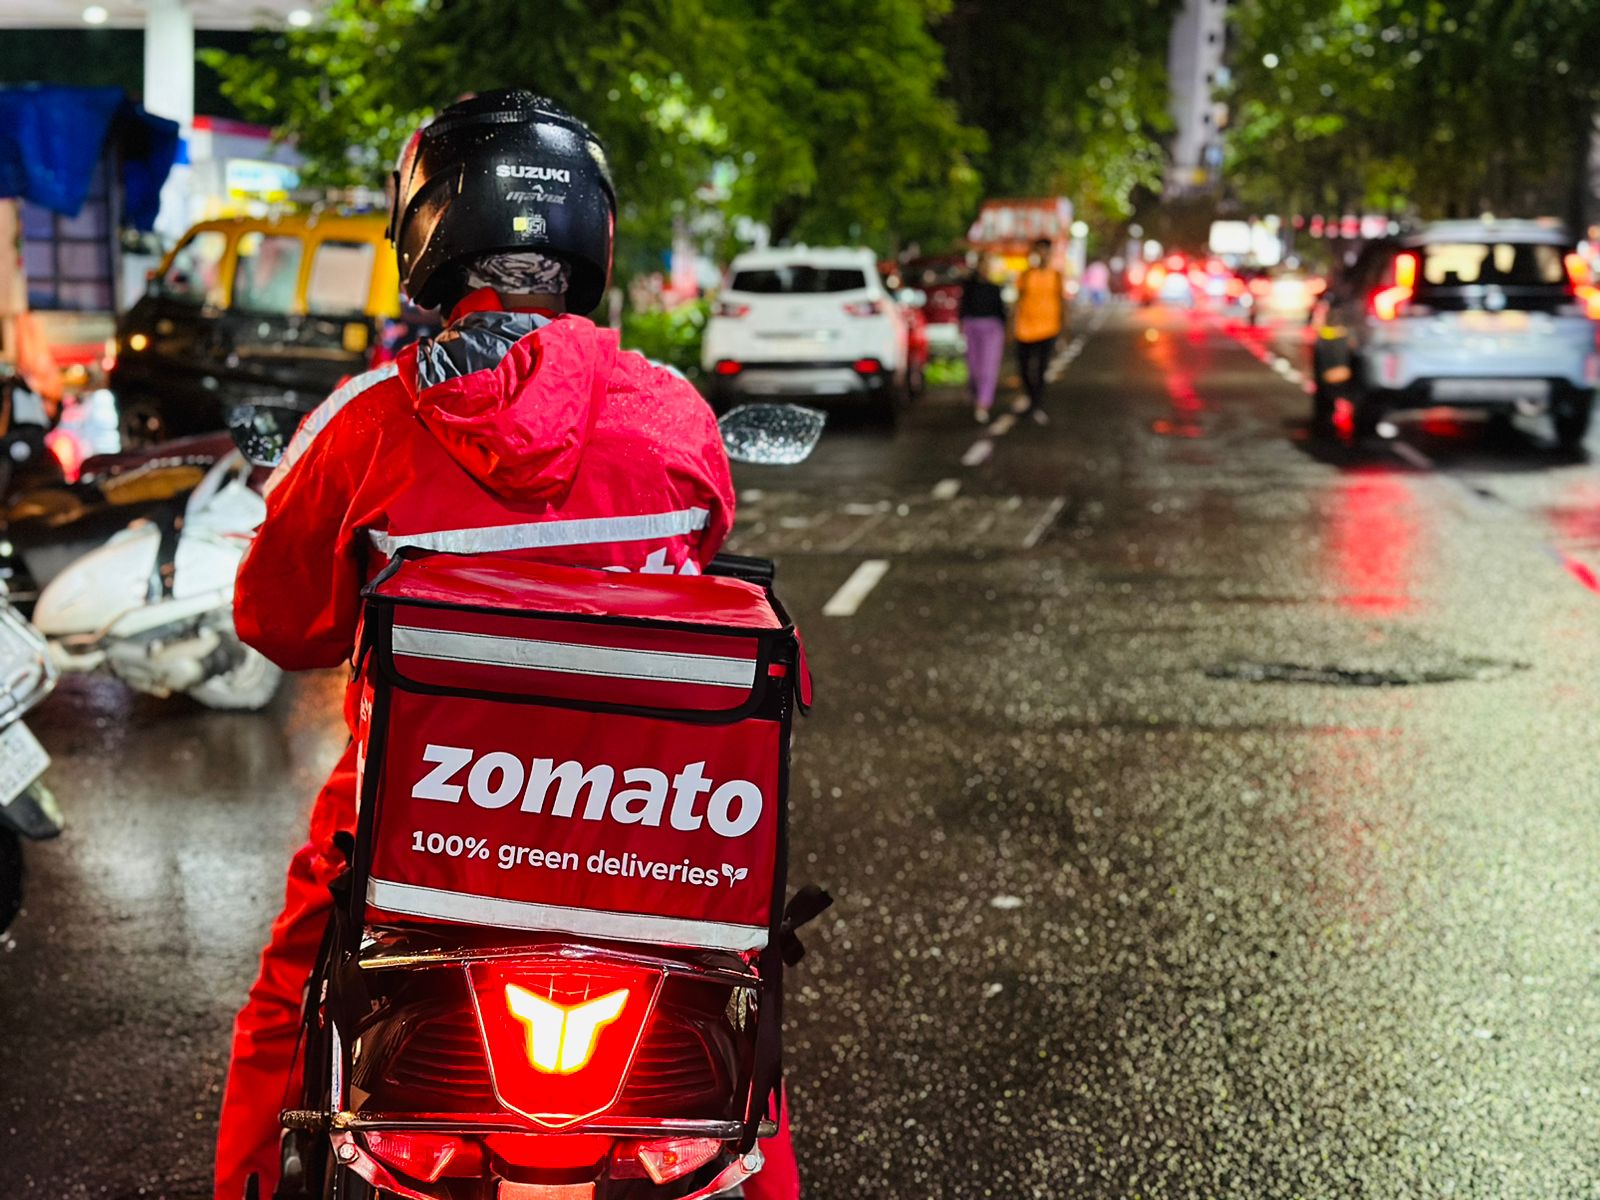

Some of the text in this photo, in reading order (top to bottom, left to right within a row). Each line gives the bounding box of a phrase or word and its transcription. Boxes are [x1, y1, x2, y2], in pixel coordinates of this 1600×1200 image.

[496, 164, 570, 183] SUZUKI
[411, 743, 763, 838] zomato
[411, 830, 719, 887] 100% green deliveries
